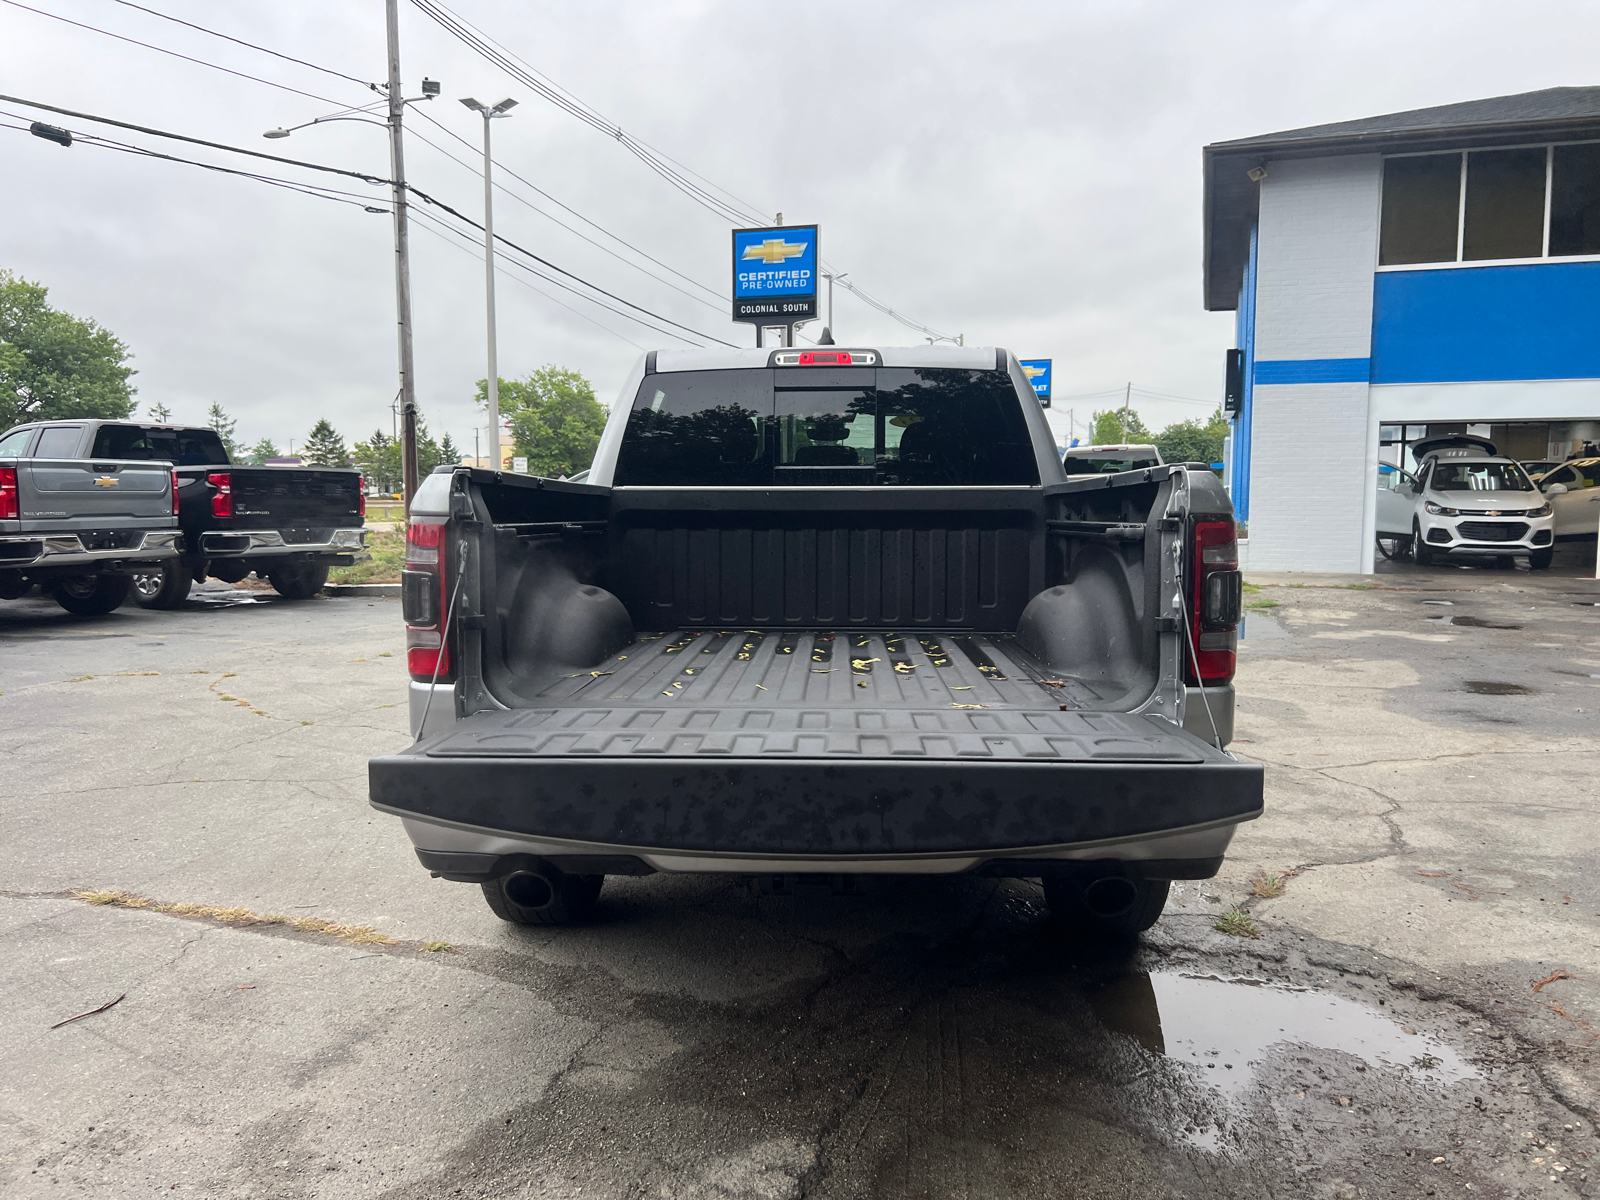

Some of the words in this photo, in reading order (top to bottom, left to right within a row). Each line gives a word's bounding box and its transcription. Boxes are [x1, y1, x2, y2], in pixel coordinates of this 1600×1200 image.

[739, 270, 810, 281] CERTIFIED
[742, 279, 807, 289] PRE-OWNED
[741, 304, 779, 313] COLONIAL
[783, 303, 808, 312] SOUTH
